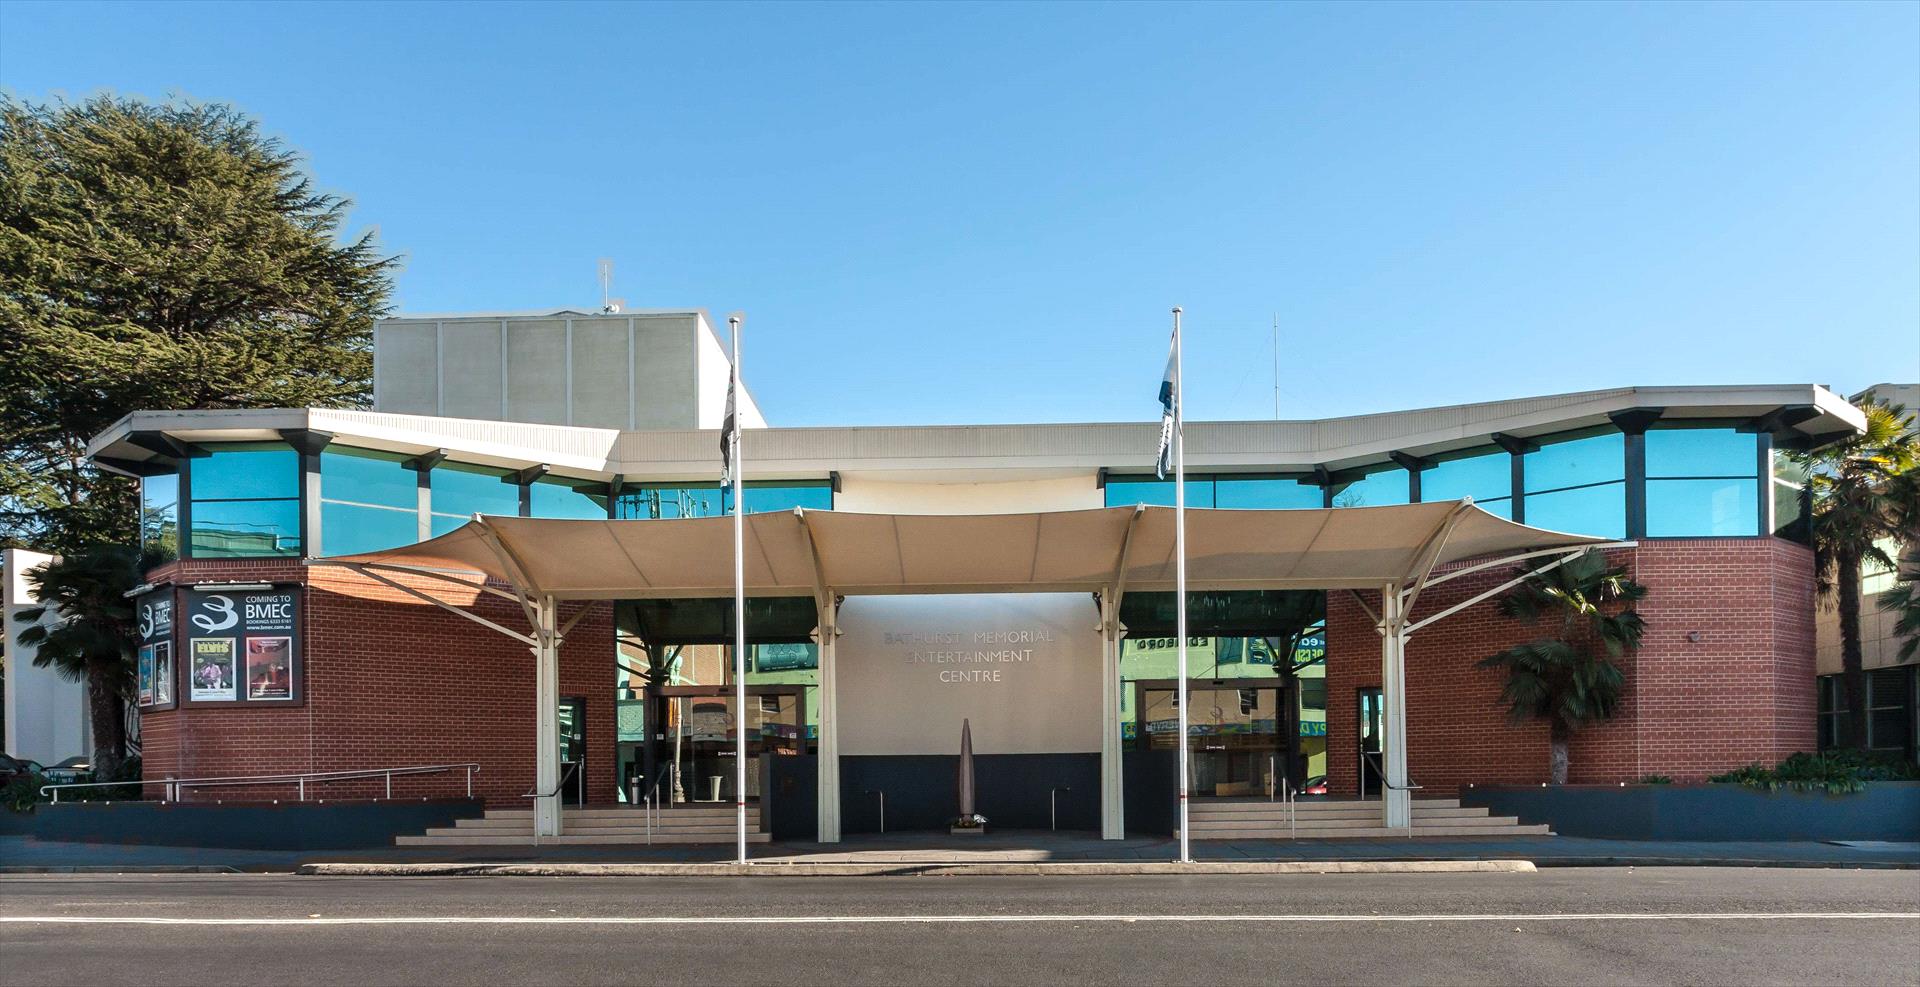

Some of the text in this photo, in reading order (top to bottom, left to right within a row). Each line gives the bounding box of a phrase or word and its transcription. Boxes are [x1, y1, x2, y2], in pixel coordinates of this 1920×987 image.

[246, 595, 291, 603] COMING TO
[155, 608, 171, 625] BMEC
[246, 603, 291, 618] BMEC
[884, 630, 1055, 645] BATHURST MEMORIAL
[904, 649, 1033, 664] ENTERTAINMENT
[939, 670, 1001, 683] CENTRE
